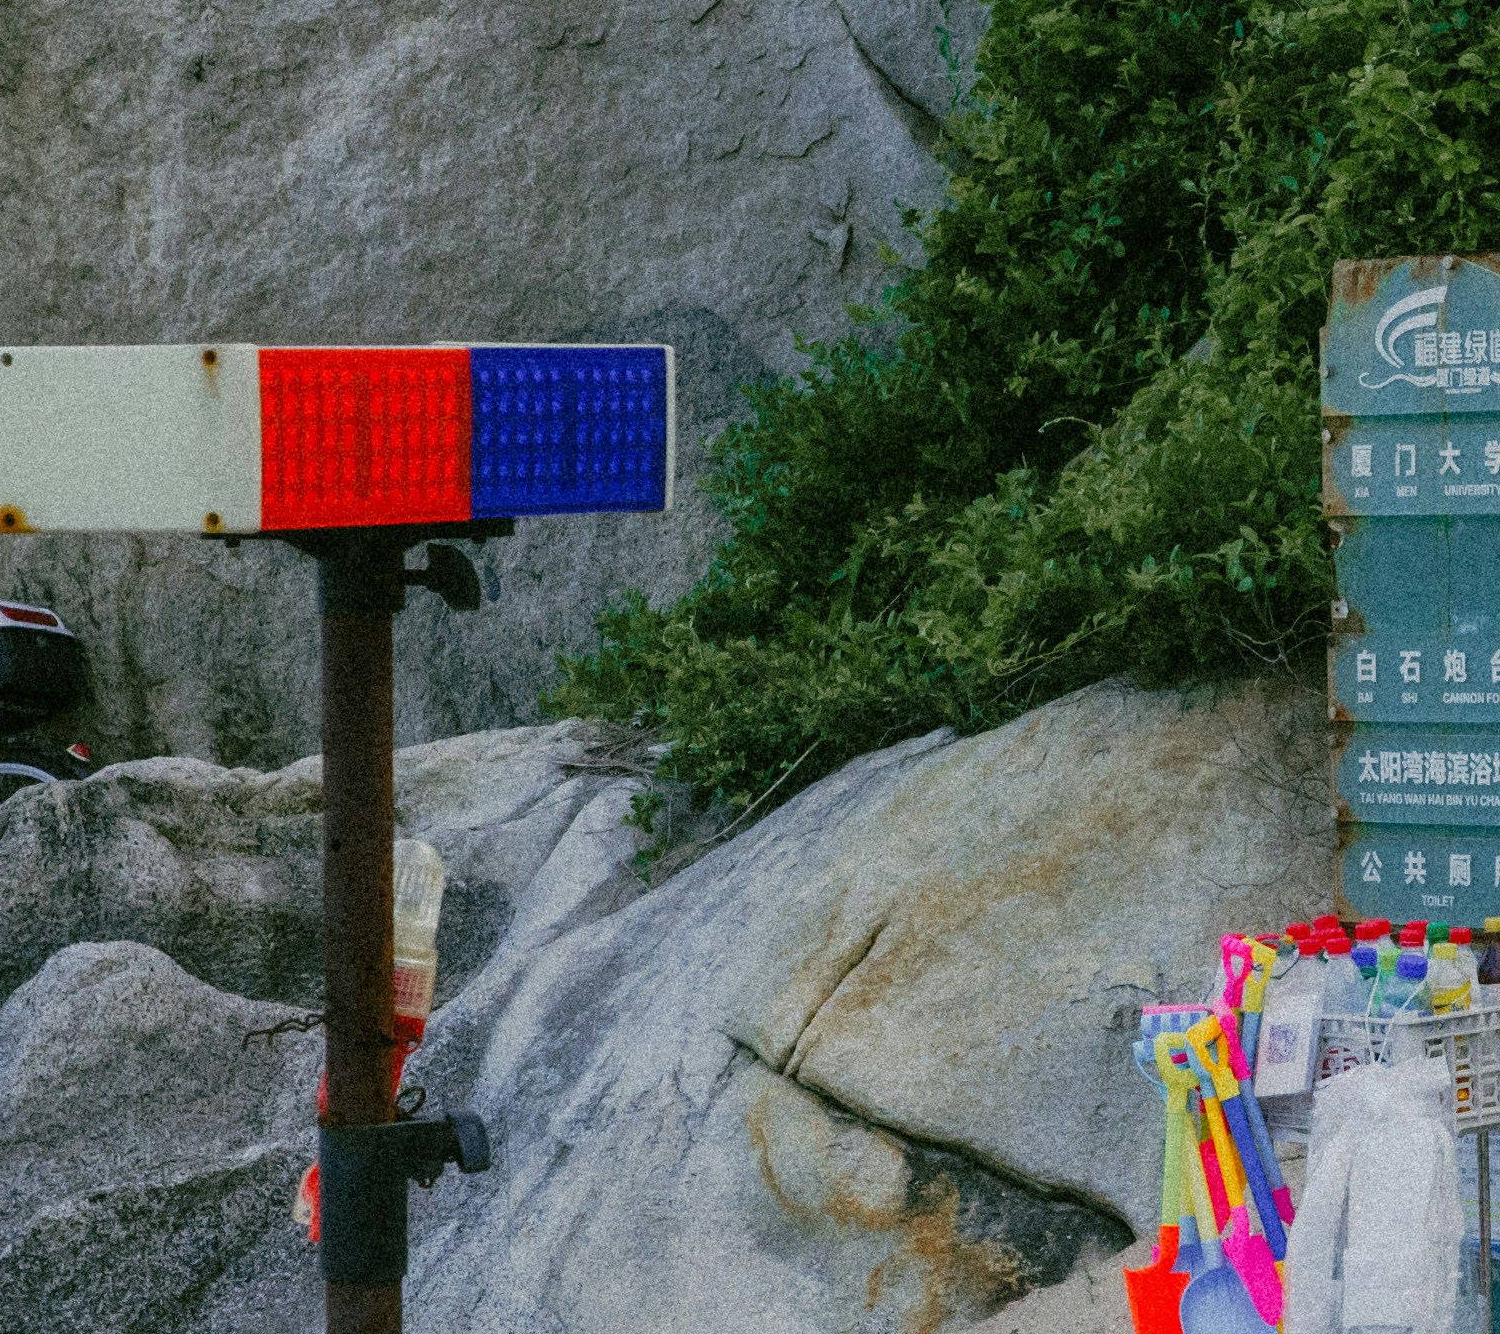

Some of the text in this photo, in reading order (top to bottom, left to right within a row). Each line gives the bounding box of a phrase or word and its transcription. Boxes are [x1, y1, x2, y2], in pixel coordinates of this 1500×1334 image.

[1354, 487, 1370, 498] XIA
[1396, 485, 1417, 497] MEN
[1357, 692, 1373, 704] BAI
[1401, 692, 1418, 704] SHI
[1443, 692, 1485, 704] CANNON
[1360, 792, 1375, 804] TAI
[1377, 793, 1403, 805] YANG
[1404, 793, 1426, 805] WAN
[1428, 794, 1444, 805] HAI
[1446, 794, 1463, 806] BIN
[1465, 795, 1479, 807] YU
[1422, 894, 1454, 907] TOILET
